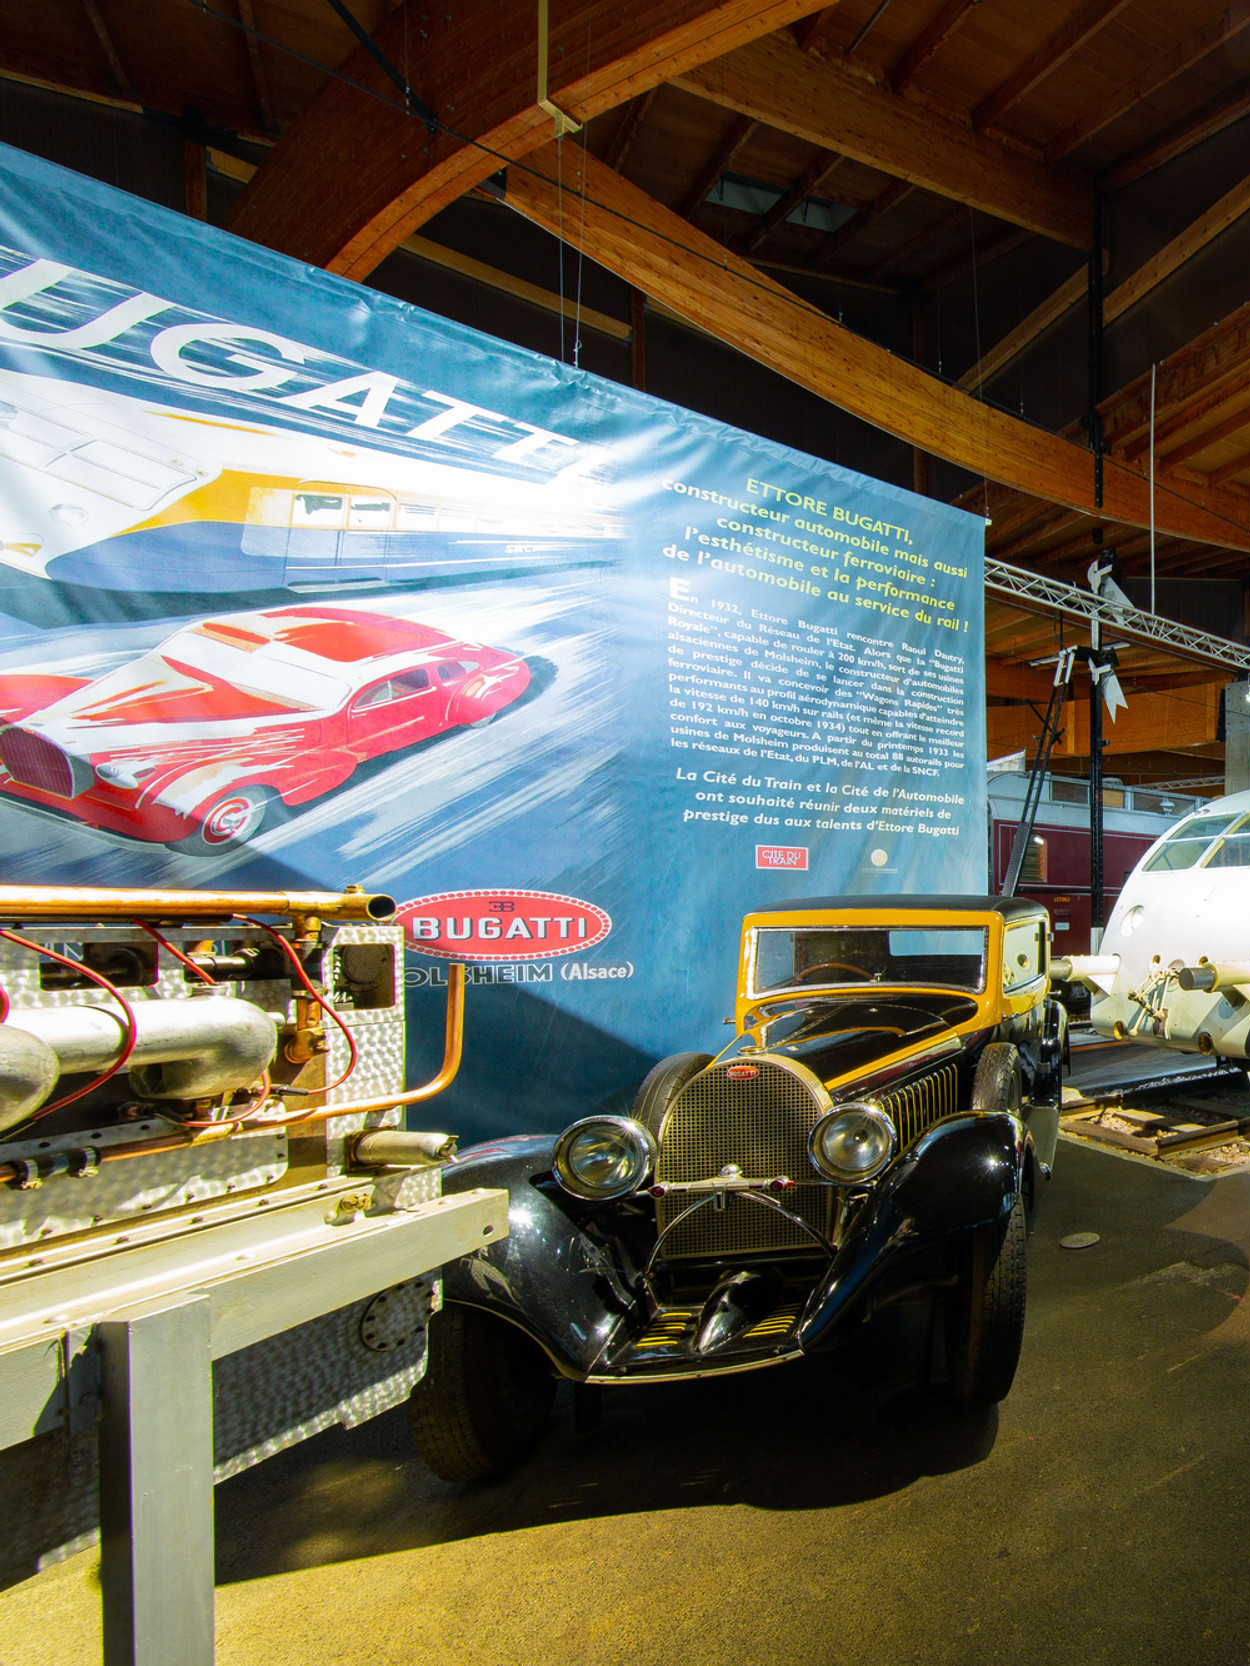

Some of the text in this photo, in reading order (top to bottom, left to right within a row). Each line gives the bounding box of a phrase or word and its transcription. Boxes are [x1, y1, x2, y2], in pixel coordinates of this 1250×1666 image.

[663, 479, 968, 578] constructeur automobile mais aussi
[746, 478, 913, 545] ETTORE BUGATTI,
[685, 526, 955, 610] l'esthétisme et la performance
[717, 518, 925, 585] constructeur ferroviaire
[662, 544, 960, 631] de l'automobile au service du rail
[668, 602, 729, 624] Directeur
[736, 619, 752, 630] du
[759, 623, 800, 640] Réseau
[806, 634, 820, 644] de
[863, 647, 891, 658] Alors
[896, 654, 912, 664] que
[670, 576, 965, 665] En 1932, Ettore Bugatti rencontre Raoul Dautry,
[667, 644, 964, 706] de prestige décide de lancer dans construction
[668, 631, 964, 695] alsaciennes de Molsheim, constructeur d'automobiles
[724, 631, 769, 646] capable
[773, 640, 787, 649] de
[791, 644, 825, 656] rouler
[838, 652, 855, 663] 200
[858, 657, 887, 670] km/h,
[888, 664, 906, 674] sort
[938, 674, 964, 684] usines
[668, 657, 737, 678] ferroviaire.
[758, 675, 771, 683] va
[778, 679, 829, 694] concevoir
[835, 688, 853, 698] des
[947, 707, 964, 716] très
[668, 673, 748, 692] performants
[750, 686, 765, 694] au
[767, 689, 796, 700] profil
[798, 694, 877, 713] aérodynamique
[878, 708, 918, 718] capables
[669, 698, 965, 748] de 192 km/h en octobre 1934) tout offrant meilleur
[670, 713, 965, 759] confort aux voyageurs. partir printemps 1933 les
[684, 687, 964, 738] vitesse de 140 km/h sur rails (et même vitesse record
[670, 726, 965, 769] usines de Molsheim produisent total autorails pour
[671, 737, 689, 748] les
[692, 741, 740, 755] réseaux
[743, 747, 758, 757] de
[760, 749, 794, 763] l'Etat,
[795, 754, 809, 763] du
[812, 755, 840, 767] PLM,
[855, 760, 875, 770] l'AL
[890, 763, 902, 772] de
[676, 767, 964, 805] La Cité du Train et la Cité de l'Automobile
[695, 792, 951, 819] ont souhaité réunir deux matériels de
[683, 809, 960, 837] prestige dus aux talents d'Ettore Bugatti
[768, 857, 797, 866] TRAIN
[412, 917, 588, 940] BUGATTI
[560, 961, 634, 981] (Alsace)
